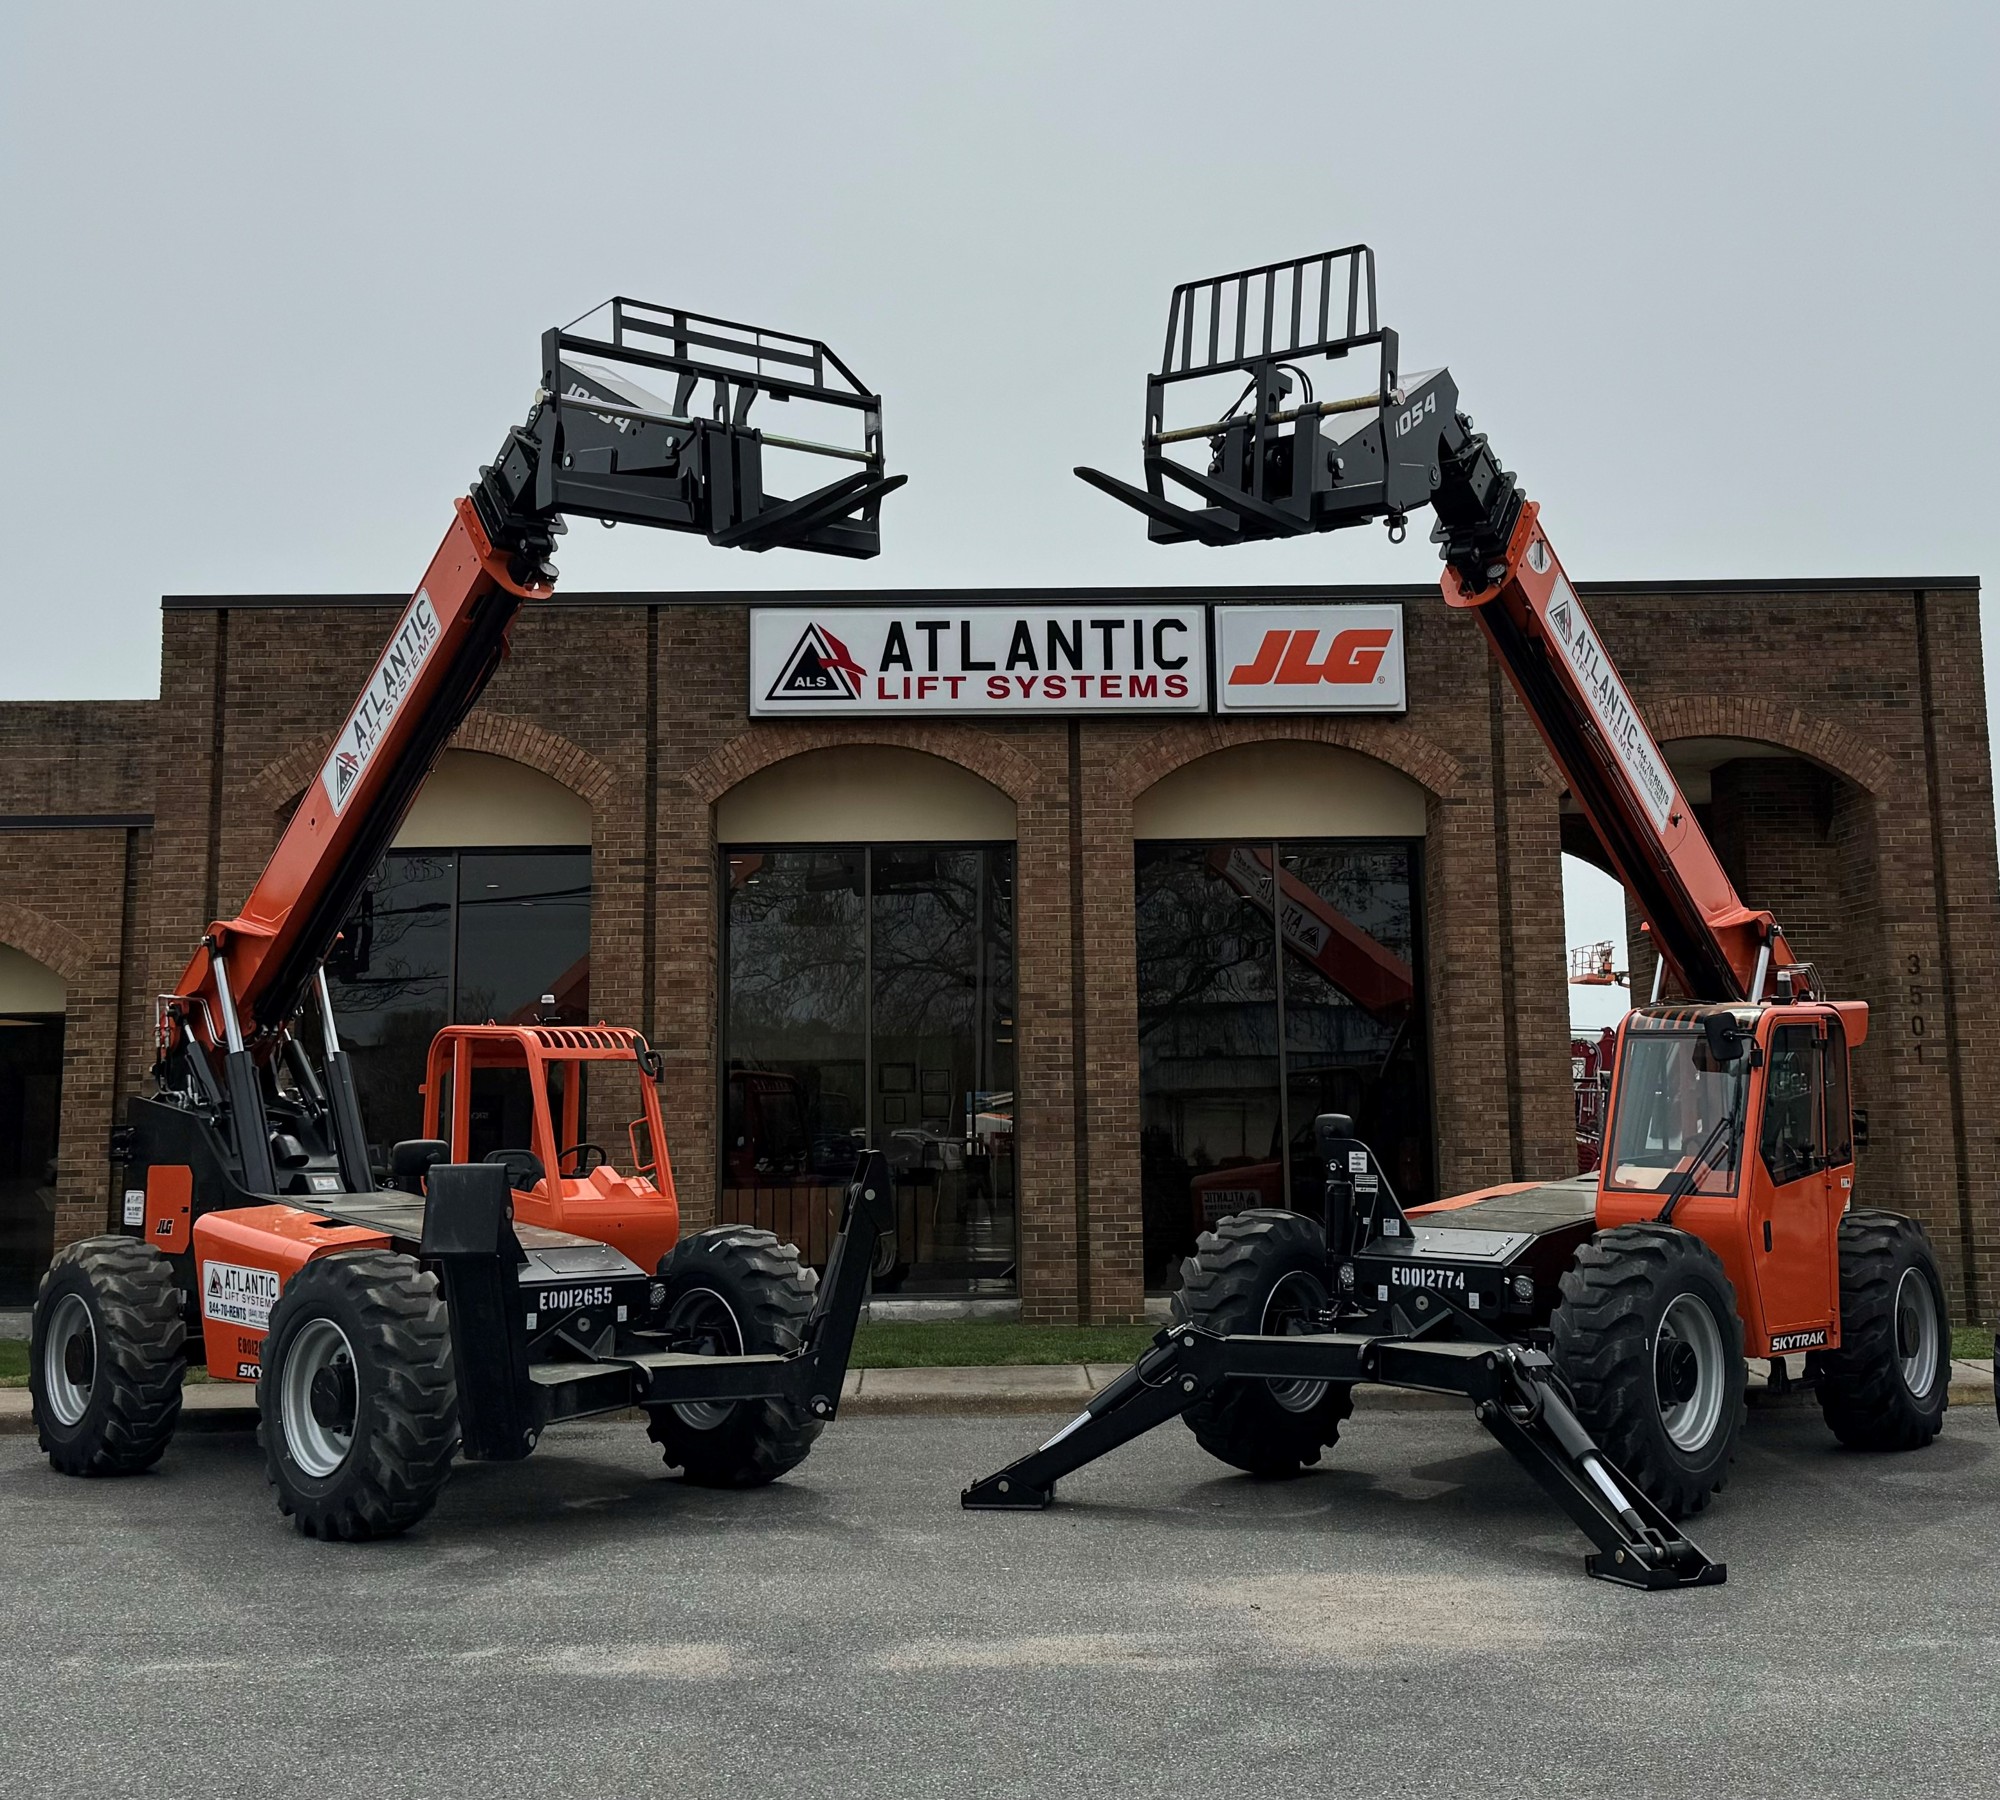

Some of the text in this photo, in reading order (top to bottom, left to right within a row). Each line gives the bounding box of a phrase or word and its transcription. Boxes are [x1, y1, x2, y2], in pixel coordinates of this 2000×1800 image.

[1395, 391, 1436, 439] 1054
[879, 618, 1189, 671] ATLANTIC
[1228, 629, 1394, 685] JLG
[353, 599, 432, 749] ATLANTIC
[793, 675, 828, 688] ALS
[878, 674, 1190, 700] LIFT SYSTEMS
[360, 621, 437, 762] LIFT SYSTEMS
[1575, 629, 1638, 750] ATLANTIC
[1572, 646, 1632, 761] LIFT SYSTEMS
[1637, 743, 1670, 805] 844-70-RENTS
[156, 1219, 174, 1235] JLG
[225, 1269, 276, 1298] ATLANTIC
[1392, 1267, 1465, 1290] E0012774
[225, 1291, 239, 1302] LIFT
[540, 1287, 612, 1310] E0012655
[209, 1302, 246, 1320] 844-70-RENTS
[238, 1336, 260, 1357] E0012
[1771, 1330, 1825, 1351] SKYTRAK
